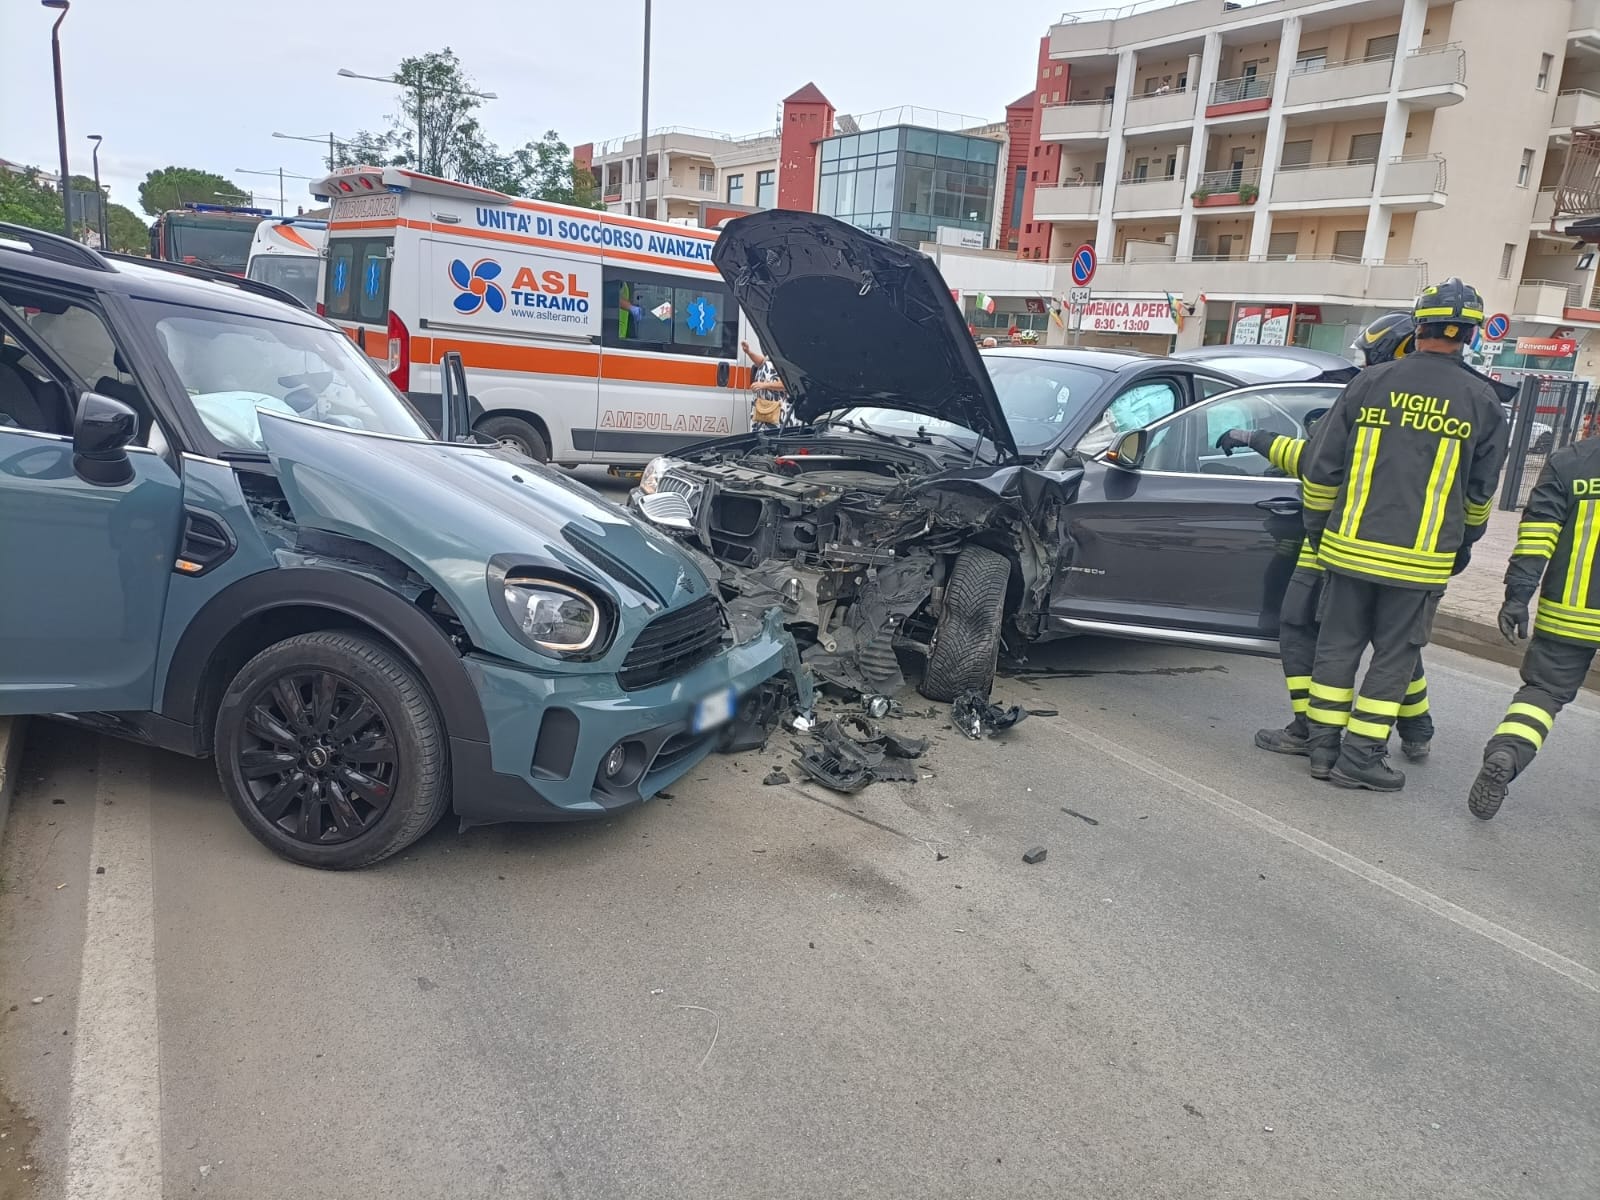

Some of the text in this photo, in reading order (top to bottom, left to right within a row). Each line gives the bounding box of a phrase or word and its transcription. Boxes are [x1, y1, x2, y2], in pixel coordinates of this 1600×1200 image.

[336, 196, 397, 219] AMBULANZA
[476, 207, 712, 260] UNITA' DI SOCCORSO AVANZAT
[511, 267, 589, 298] ASL
[511, 291, 589, 313] TERAMO
[1132, 303, 1170, 318] APERT
[511, 309, 589, 325] www.aslteramo.it
[1094, 319, 1115, 329] 8:30
[1123, 320, 1149, 331] 13:00
[1518, 342, 1558, 351] Benvenuti
[1390, 391, 1450, 416] VIGILI
[600, 410, 729, 434] AMBULANZA
[1400, 411, 1472, 439] FUOCO
[1572, 478, 1600, 496] DE
